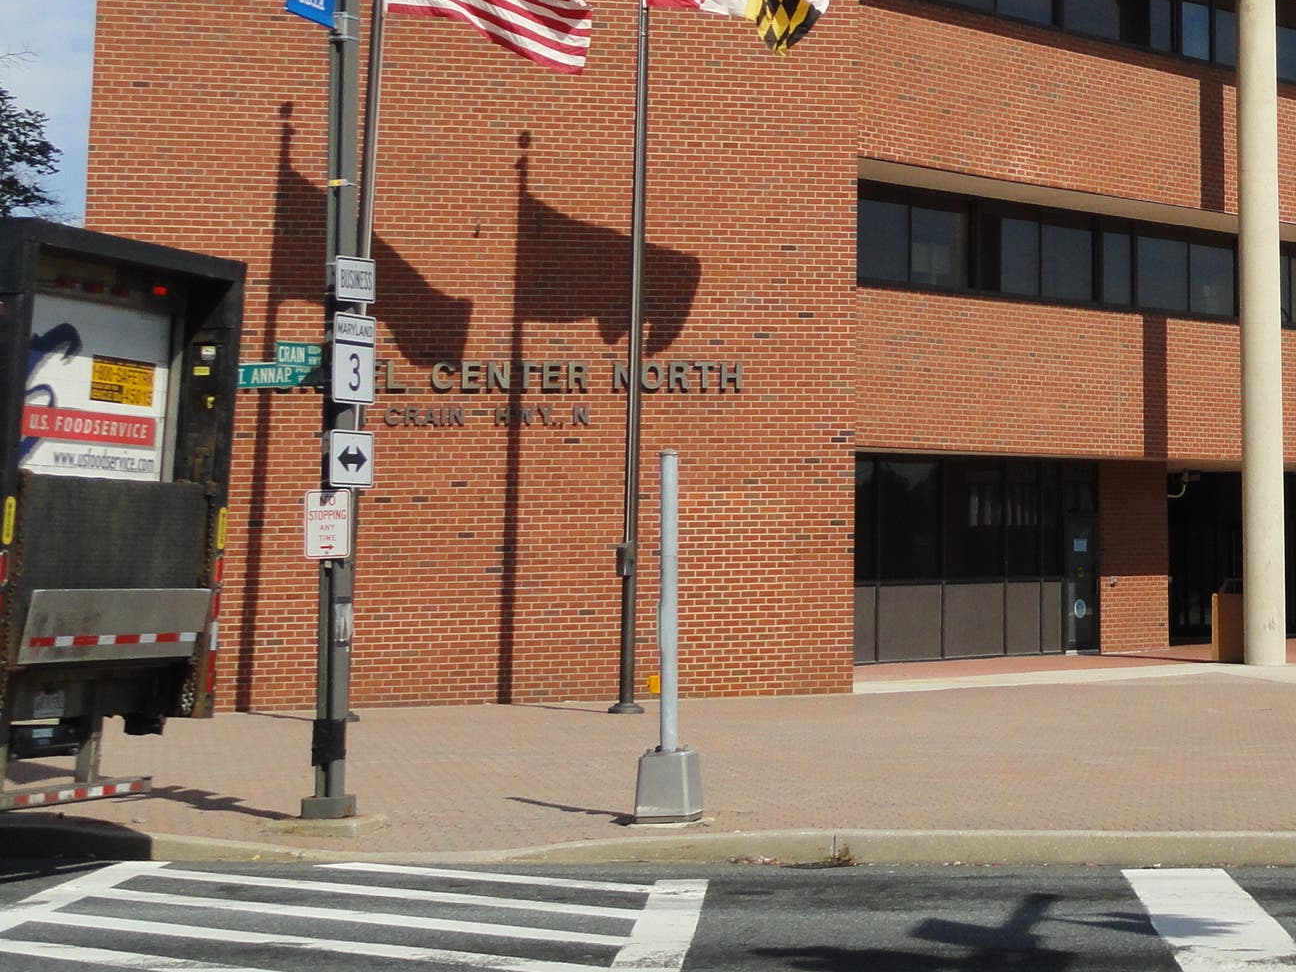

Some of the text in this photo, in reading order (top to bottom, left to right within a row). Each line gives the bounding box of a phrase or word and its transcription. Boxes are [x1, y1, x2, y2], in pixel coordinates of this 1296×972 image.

[341, 269, 373, 291] BUSINESS
[337, 321, 373, 338] MARYLAND
[278, 345, 305, 363] CRAIN
[349, 353, 360, 391] 3
[432, 362, 588, 393] CENTER
[613, 361, 744, 393] NORTH
[29, 414, 149, 439] U.S. FOODSERVICE
[384, 406, 464, 427] CRAIN
[572, 406, 590, 426] N
[53, 448, 155, 473] www.usfoodservice.com
[320, 494, 336, 506] NO
[308, 509, 347, 521] STOPPING
[319, 534, 337, 542] TIME
